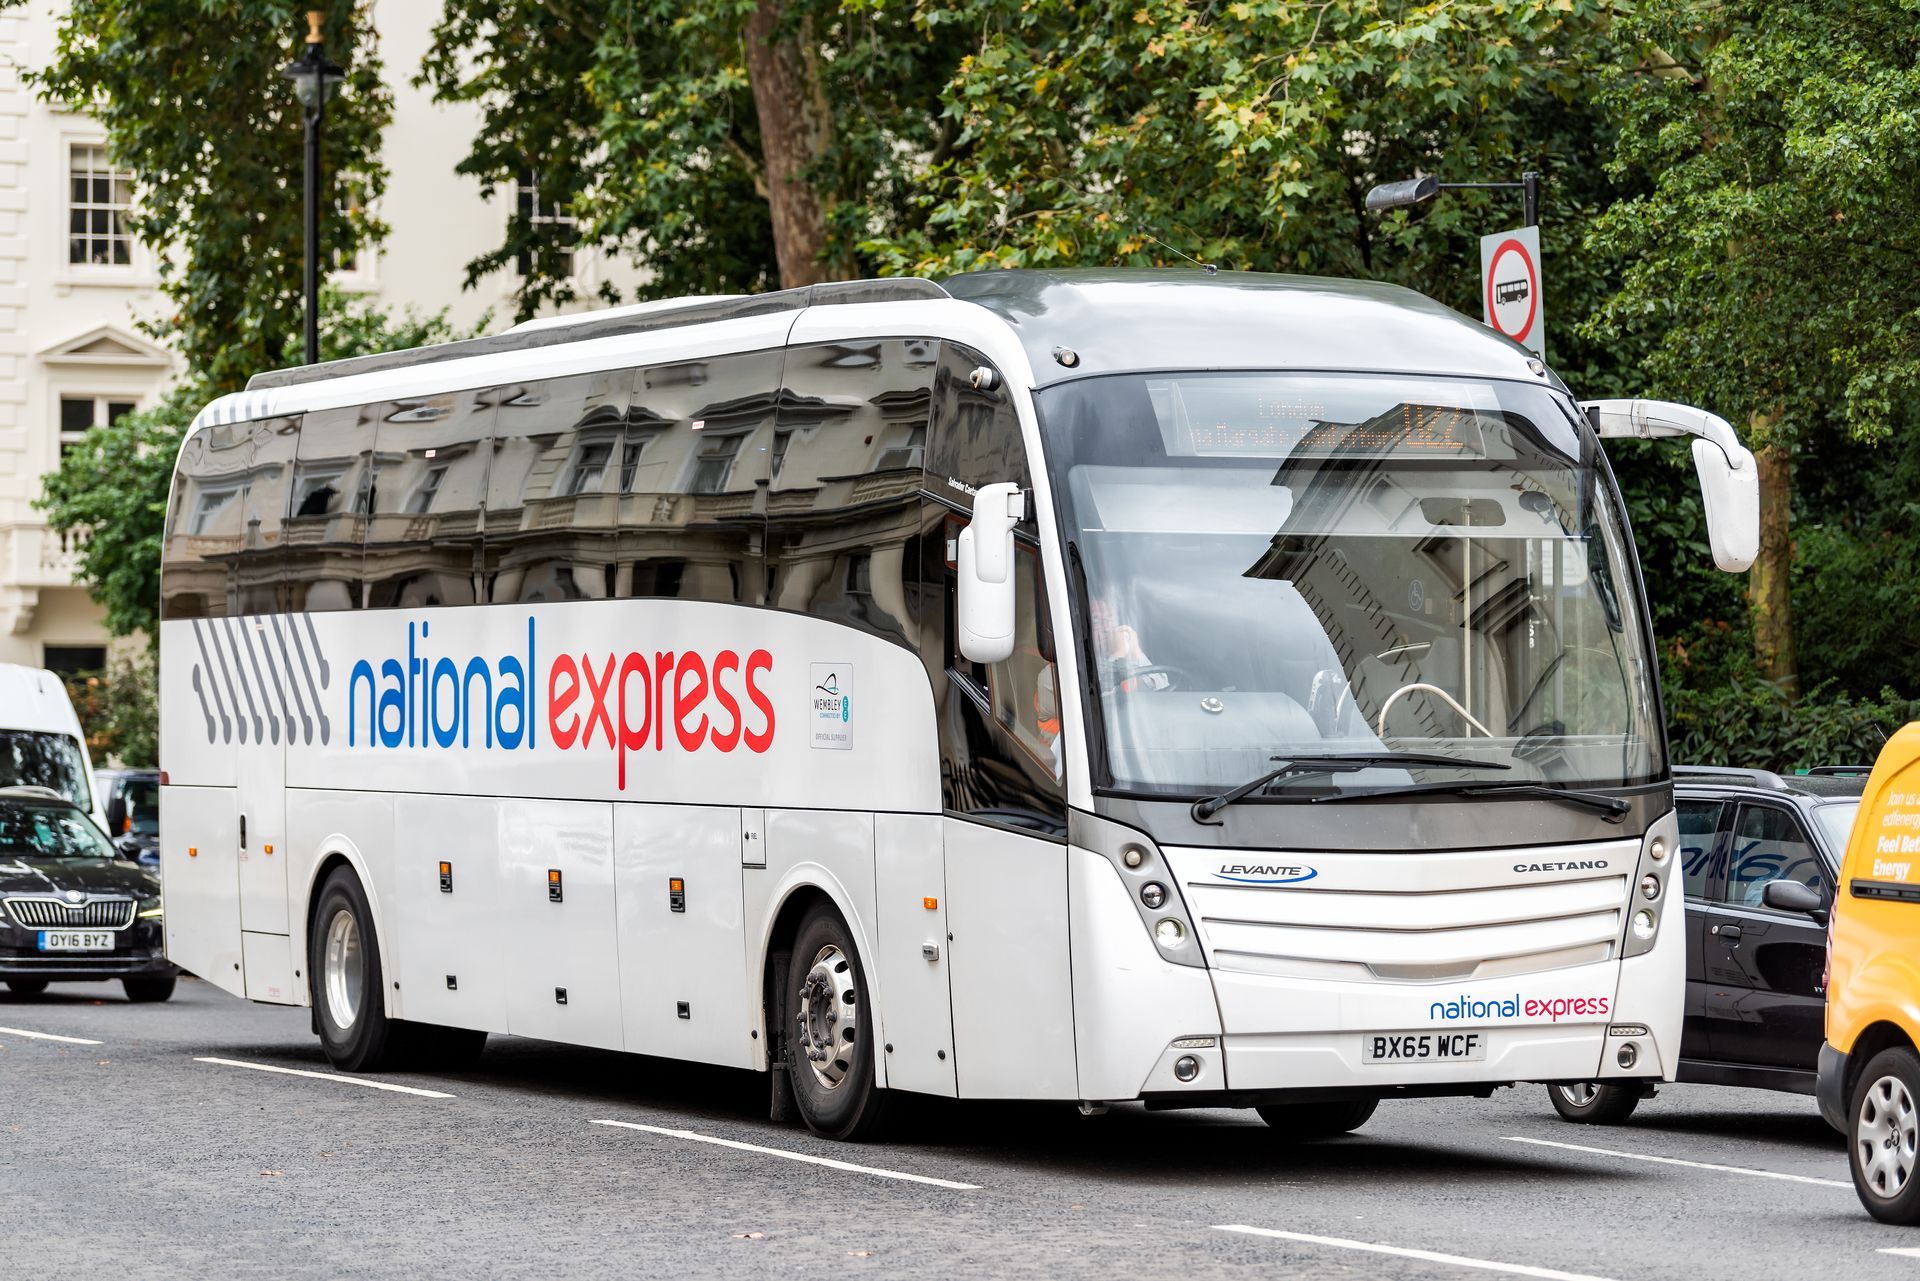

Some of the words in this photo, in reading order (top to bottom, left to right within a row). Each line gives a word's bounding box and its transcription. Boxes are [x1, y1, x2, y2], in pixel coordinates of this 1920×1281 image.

[349, 616, 535, 750] national
[549, 649, 775, 791] express
[814, 698, 841, 710] WEMBLEY
[1887, 791, 1904, 806] Join
[1905, 792, 1915, 805] us
[1876, 834, 1901, 853] Feel
[1220, 865, 1302, 876] LEVANTE
[1513, 860, 1609, 873] CAETANO
[1872, 858, 1911, 881] Energy
[50, 934, 80, 947] OY16
[83, 934, 109, 947] BYZ
[1430, 993, 1520, 1020] national
[1525, 997, 1609, 1022] express
[1373, 1036, 1431, 1059] BX65
[1437, 1034, 1479, 1057] WCF
